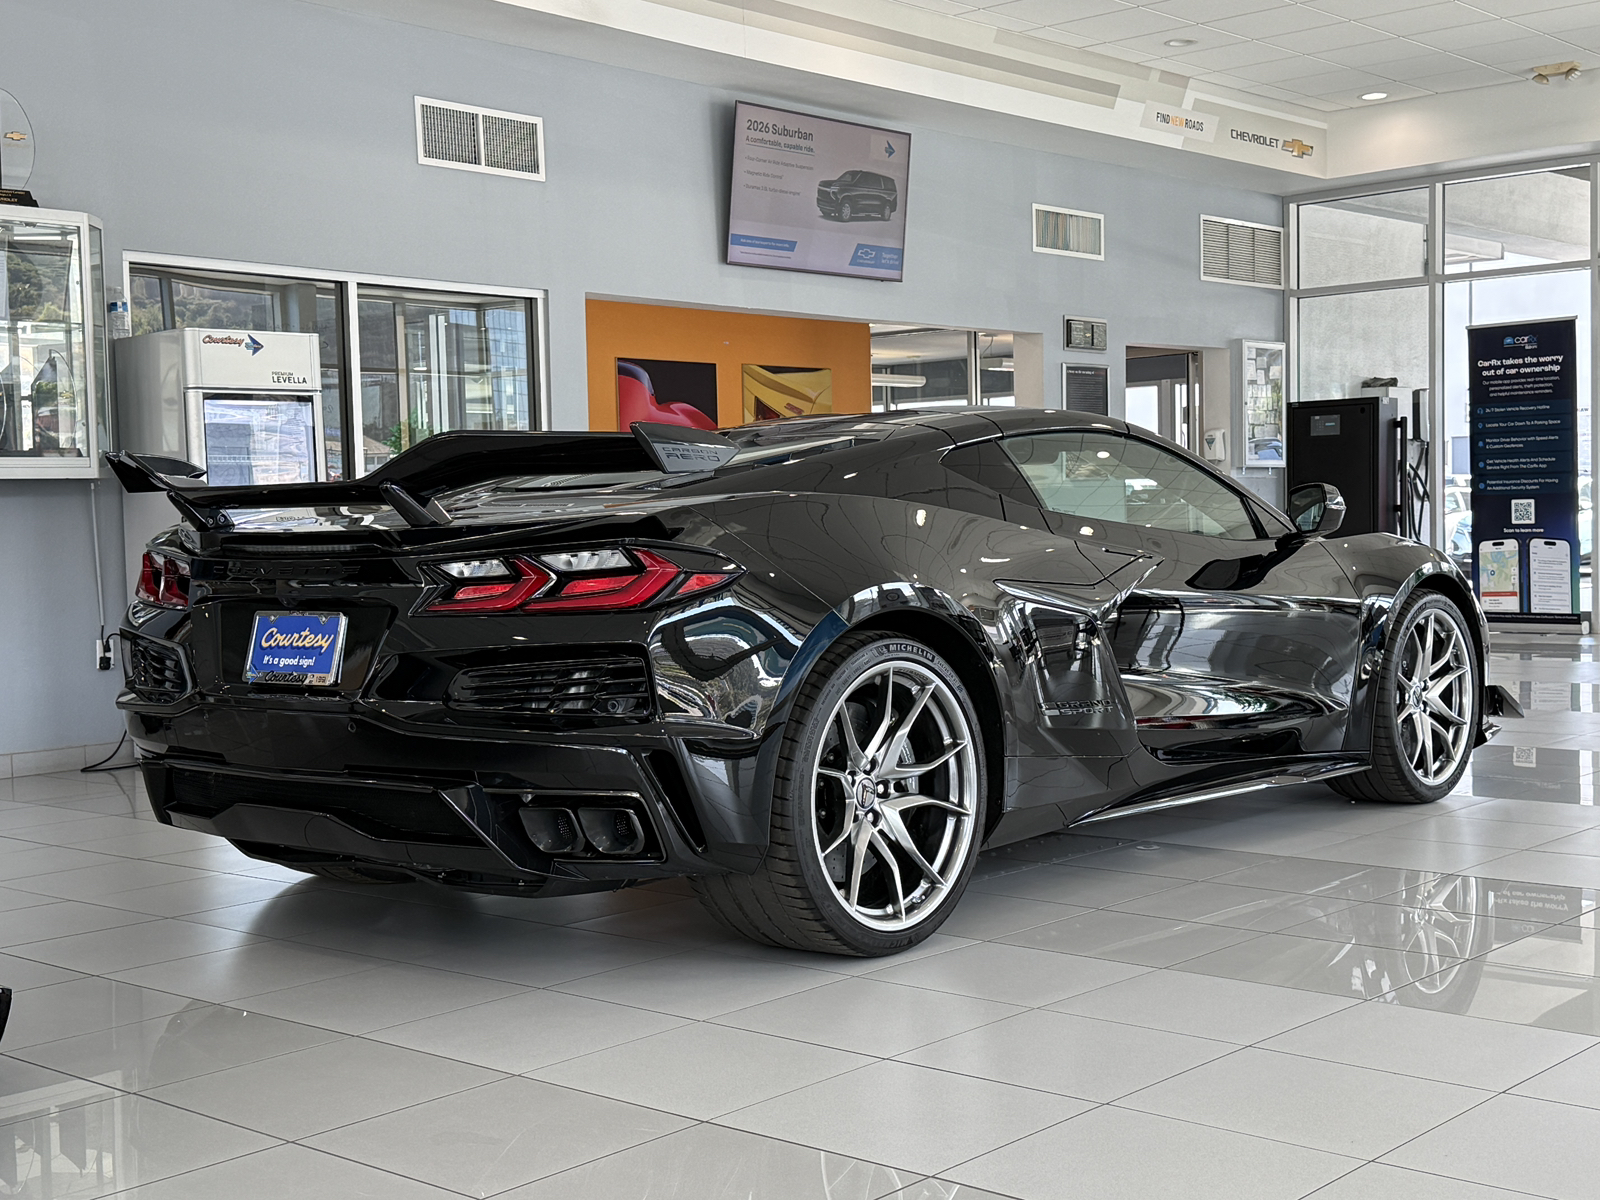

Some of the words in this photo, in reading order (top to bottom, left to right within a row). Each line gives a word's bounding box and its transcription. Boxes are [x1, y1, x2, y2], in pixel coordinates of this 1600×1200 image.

[1156, 111, 1170, 125] FIND
[1170, 115, 1184, 128] NEW
[1184, 118, 1204, 132] ROADS
[746, 118, 770, 134] 2026
[771, 124, 814, 142] Suburban
[750, 137, 782, 148] comfortable,
[784, 142, 804, 152] capable
[1230, 128, 1280, 149] CHEVROLET
[202, 334, 245, 348] Courtesy
[1478, 359, 1502, 367] CarRx
[1502, 357, 1524, 365] takes
[1520, 364, 1560, 373] ownership
[272, 376, 308, 384] LEVELLA
[662, 446, 718, 455] CARBON
[665, 452, 720, 462] AERO
[261, 627, 334, 654] Courtesy
[889, 644, 932, 660] MICHELIN
[263, 655, 272, 664] It's
[279, 656, 299, 667] good
[299, 656, 316, 668] sign!
[1060, 706, 1113, 716] SPORT
